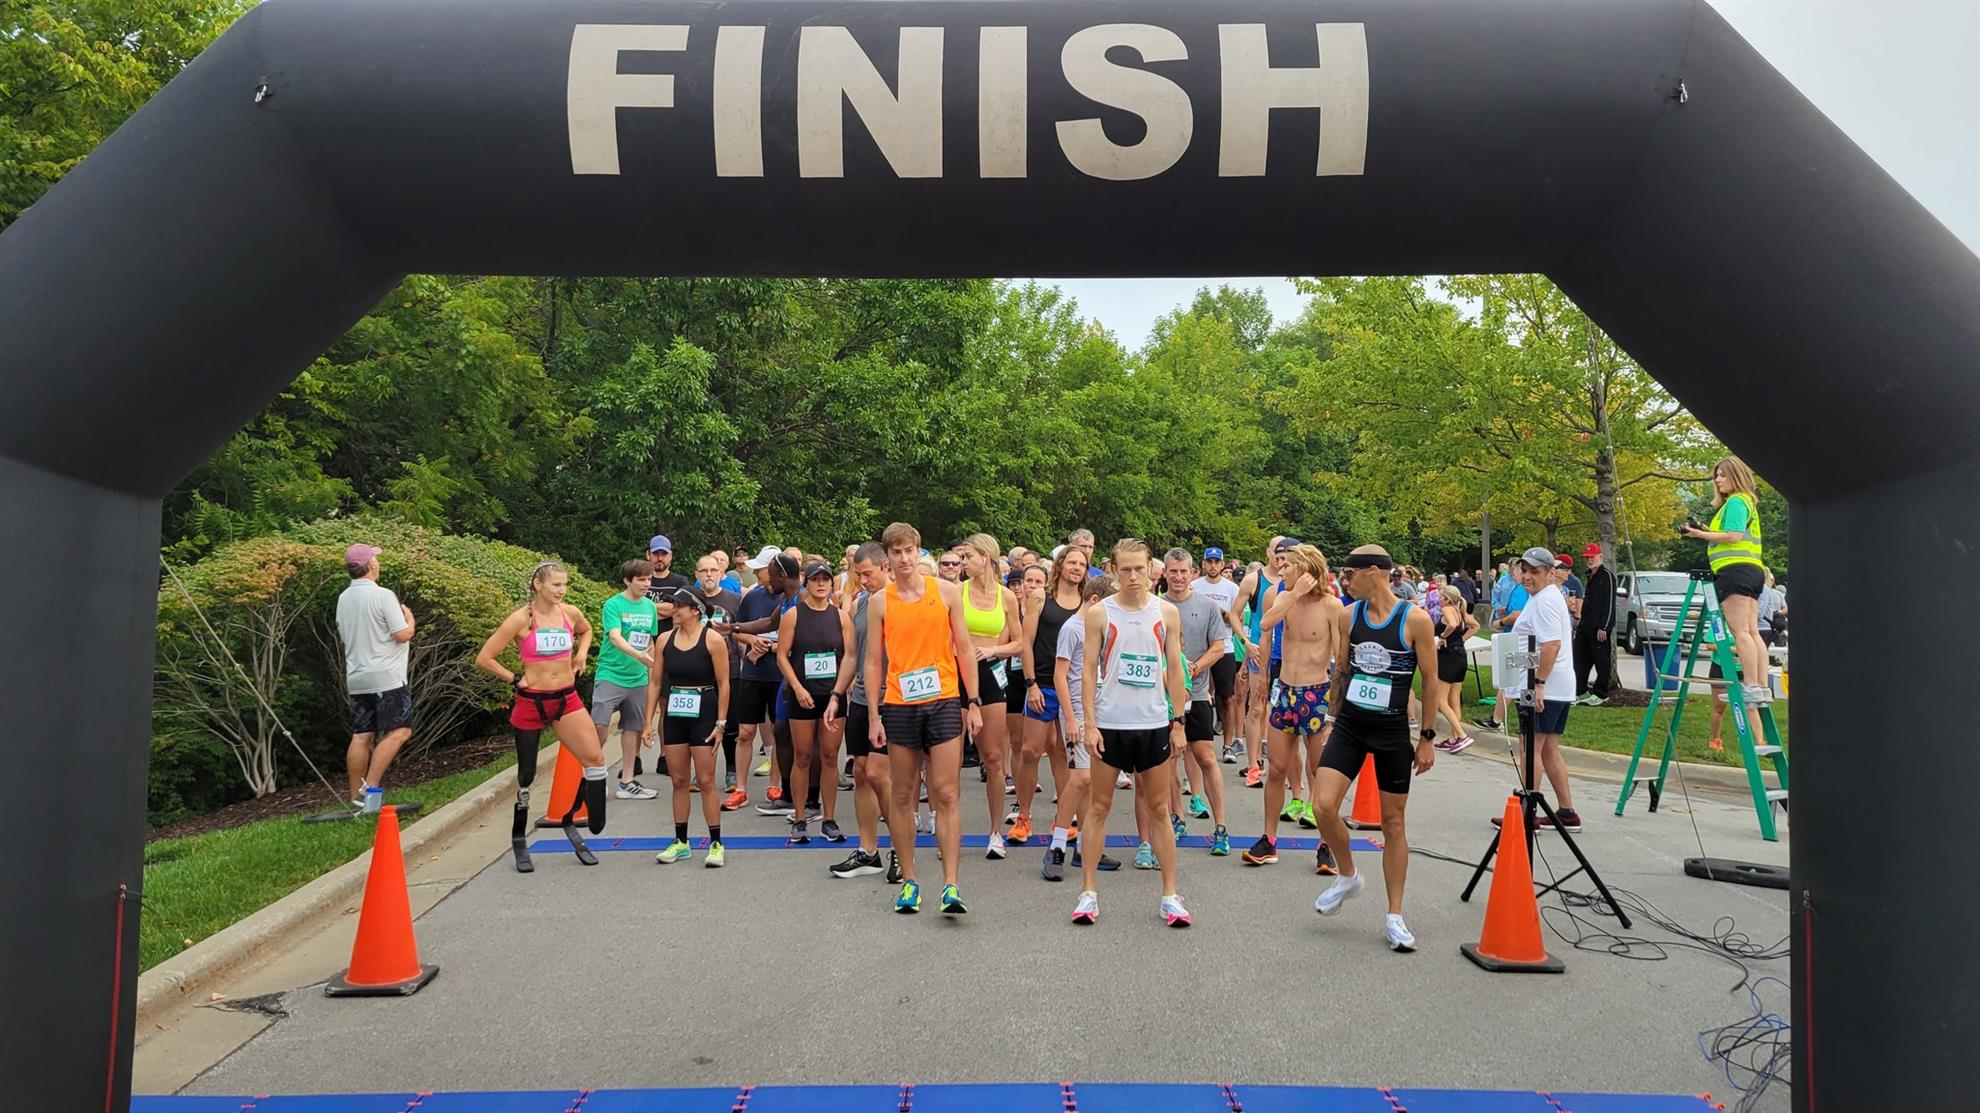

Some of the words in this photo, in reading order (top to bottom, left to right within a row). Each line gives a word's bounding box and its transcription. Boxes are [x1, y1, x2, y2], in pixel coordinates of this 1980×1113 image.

[567, 23, 1370, 181] FINISH
[543, 636, 567, 647] 170
[814, 660, 828, 671] 20
[1126, 663, 1151, 678] 383
[907, 676, 934, 693] 212
[1359, 684, 1378, 700] 86
[672, 696, 694, 709] 358
